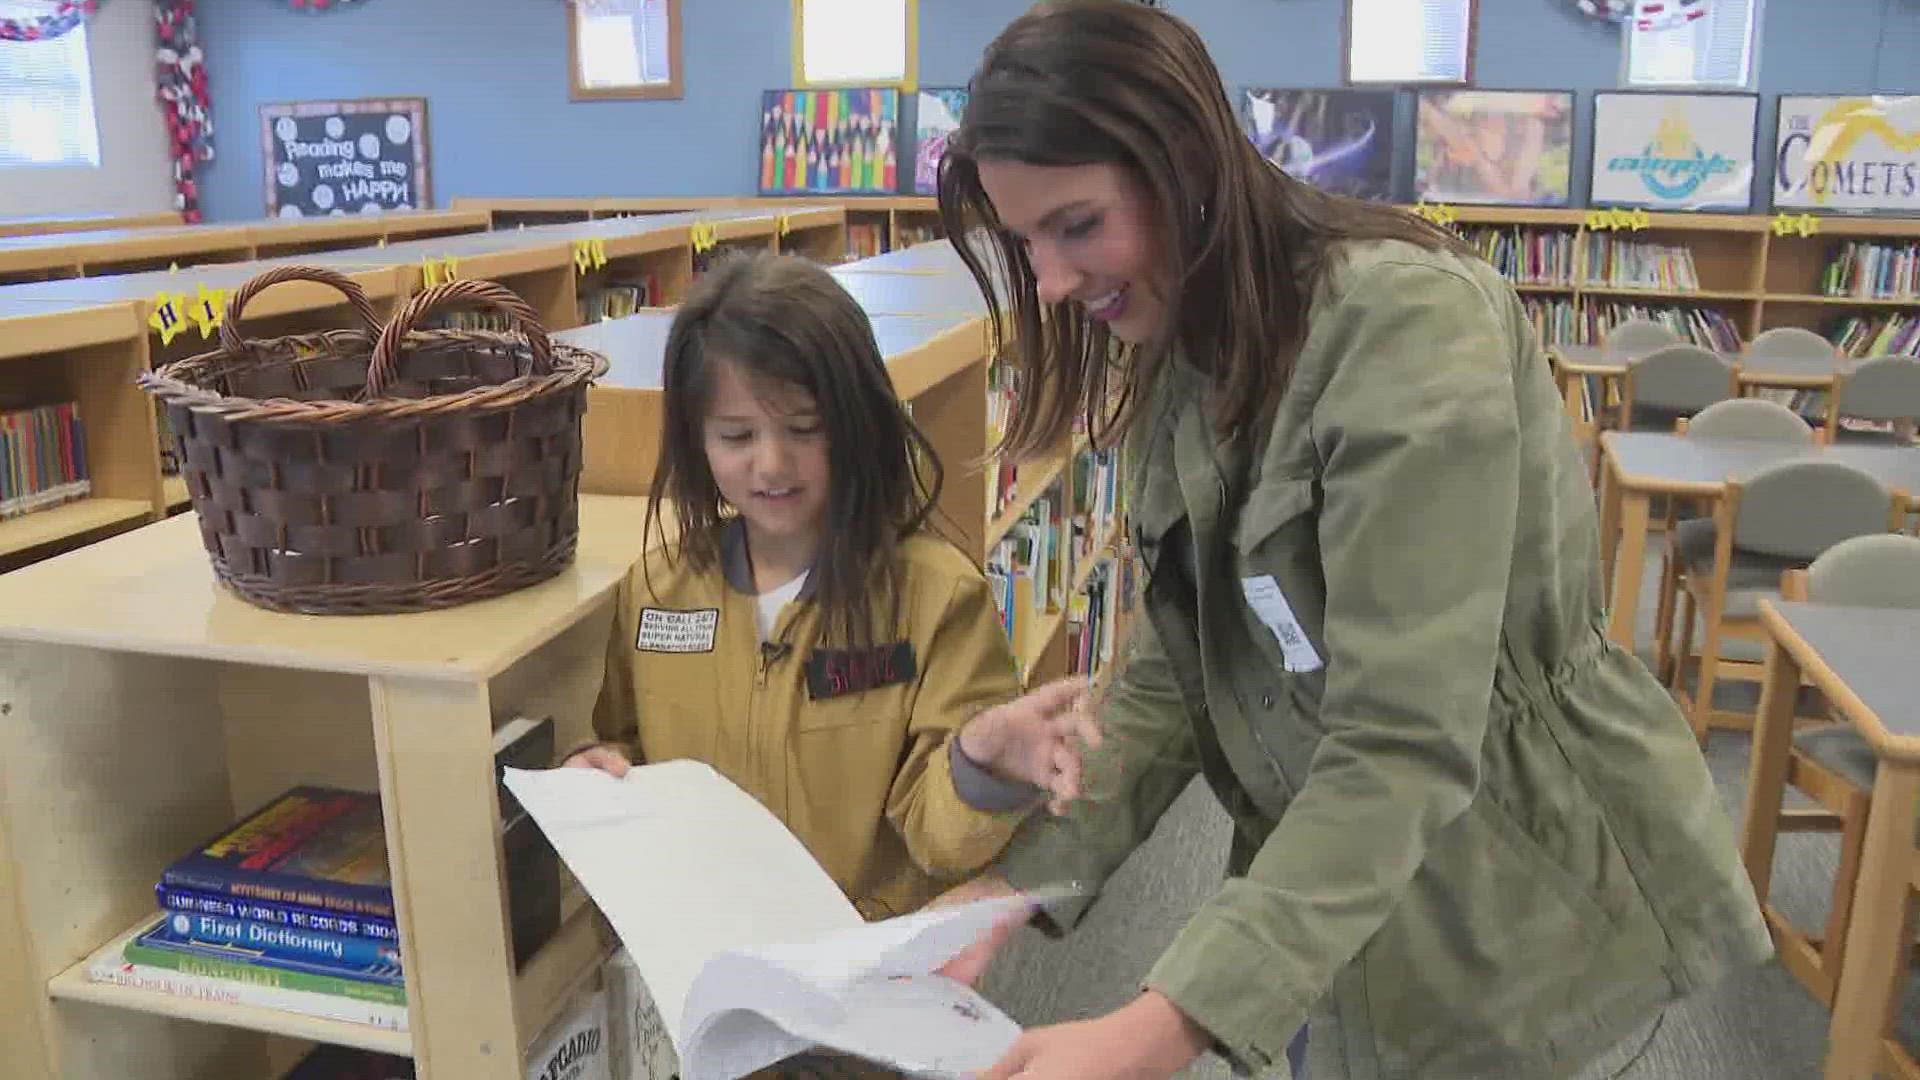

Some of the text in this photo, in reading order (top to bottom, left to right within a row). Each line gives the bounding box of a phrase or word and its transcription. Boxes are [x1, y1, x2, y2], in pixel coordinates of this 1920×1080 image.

[284, 137, 354, 161] Reading
[318, 159, 407, 178] makes me
[1779, 133, 1917, 195] COMETS
[342, 179, 408, 202] HAPPY!
[158, 301, 177, 330] H
[168, 895, 234, 916] GUINNESS
[238, 904, 288, 924] WORLD
[292, 912, 358, 933] RECORDS
[200, 916, 343, 959] First Dictionary
